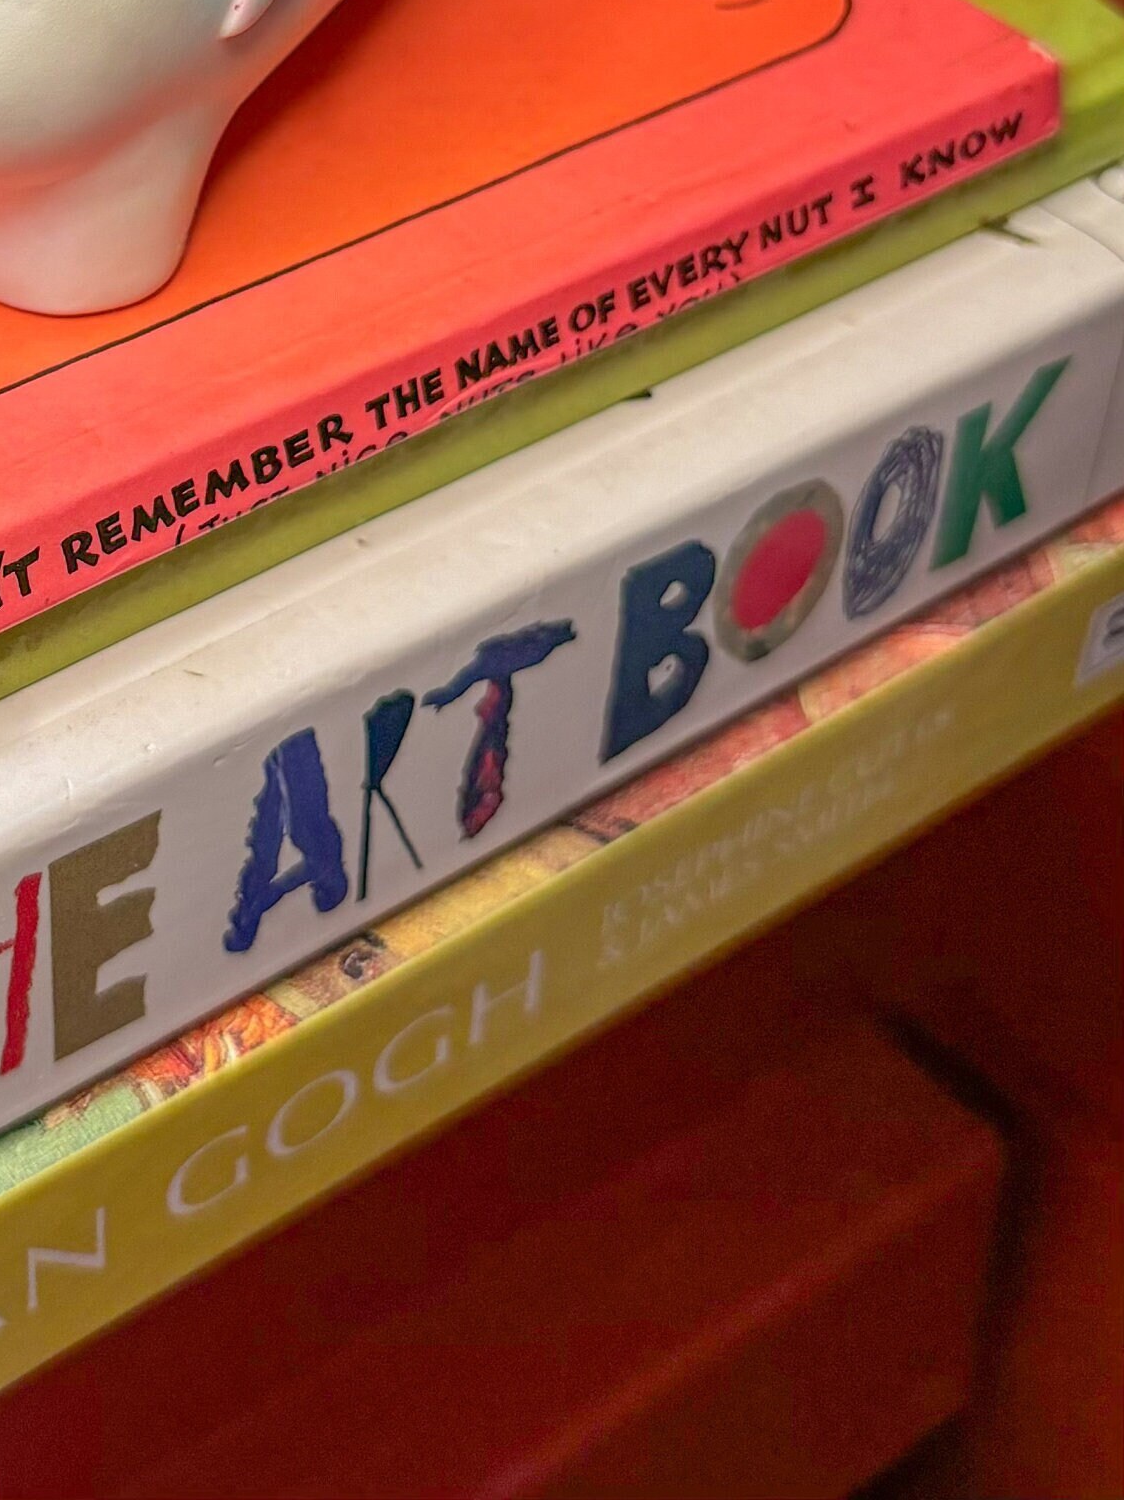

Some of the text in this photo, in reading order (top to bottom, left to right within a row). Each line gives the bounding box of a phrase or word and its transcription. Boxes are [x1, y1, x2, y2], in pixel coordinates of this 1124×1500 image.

[60, 412, 354, 575] REMEMBER
[364, 367, 446, 431] THE
[453, 315, 562, 391] NAME
[567, 288, 617, 334] OF
[626, 230, 750, 313] EVERY
[757, 195, 833, 258] NUT
[848, 174, 877, 211] I
[898, 110, 1026, 189] KNOW
[223, 617, 576, 953] ART
[599, 355, 1073, 768] BOOK
[165, 948, 544, 1218] GOGH
